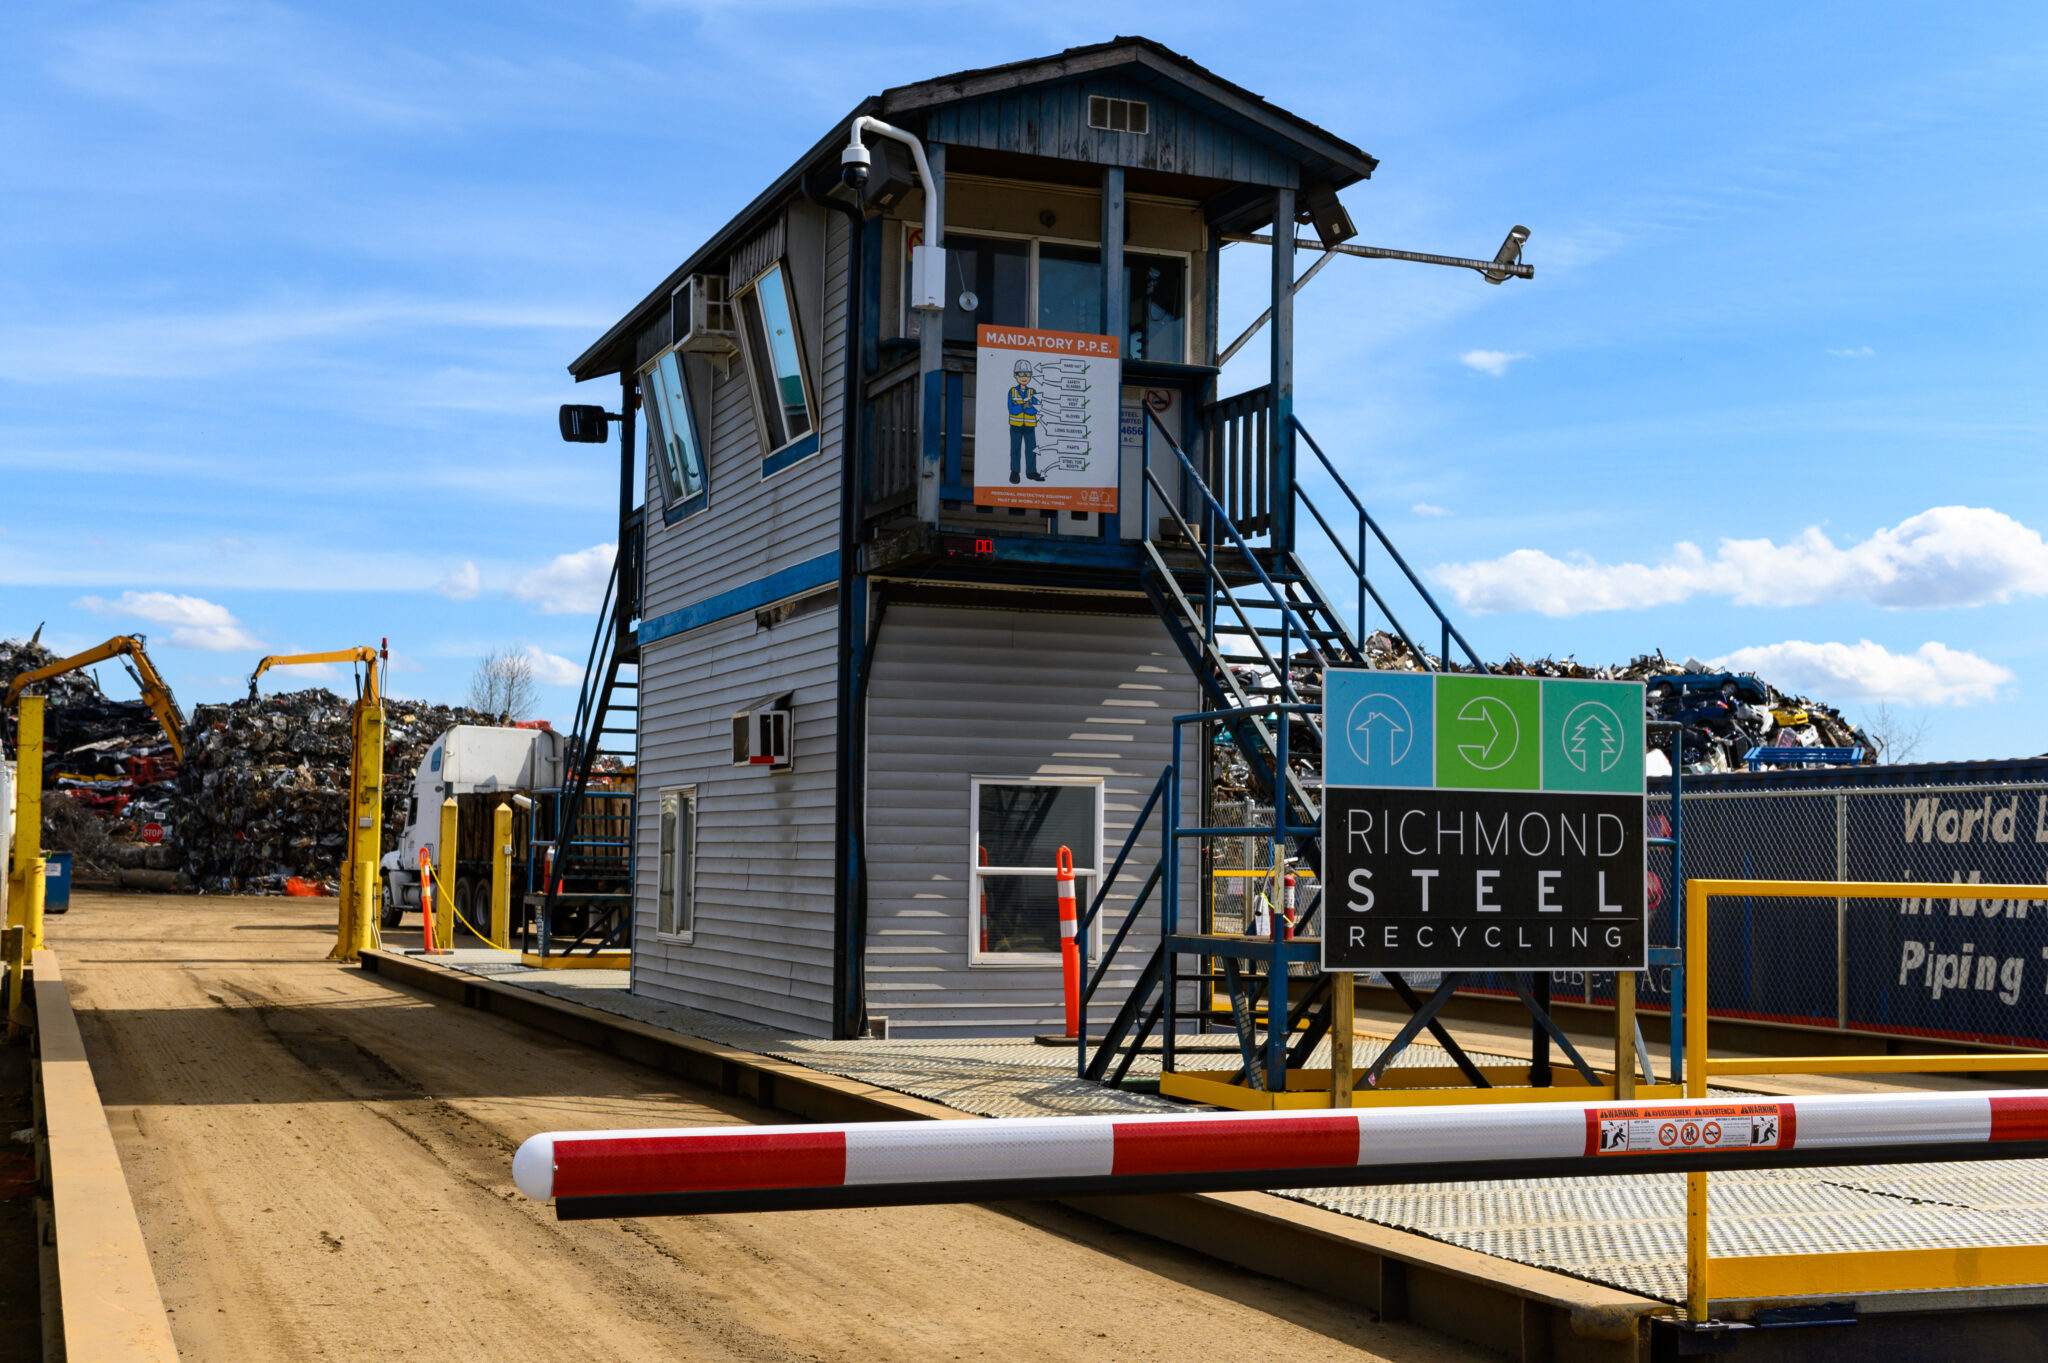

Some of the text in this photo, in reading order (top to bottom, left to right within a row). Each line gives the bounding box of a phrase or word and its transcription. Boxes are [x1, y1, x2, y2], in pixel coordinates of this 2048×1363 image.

[986, 332, 1112, 353] MANDATORY P.P.E.
[143, 828, 162, 838] STOP
[1348, 808, 1624, 858] RICHMOND
[1904, 795, 2018, 844] World
[1347, 867, 1623, 913] STEEL
[1349, 925, 1622, 948] RECYCLING
[1899, 940, 2024, 1006] Piping
[1607, 1105, 1778, 1118] WARNING AVERTISSEMENT ADVERTENCIA WARNING
